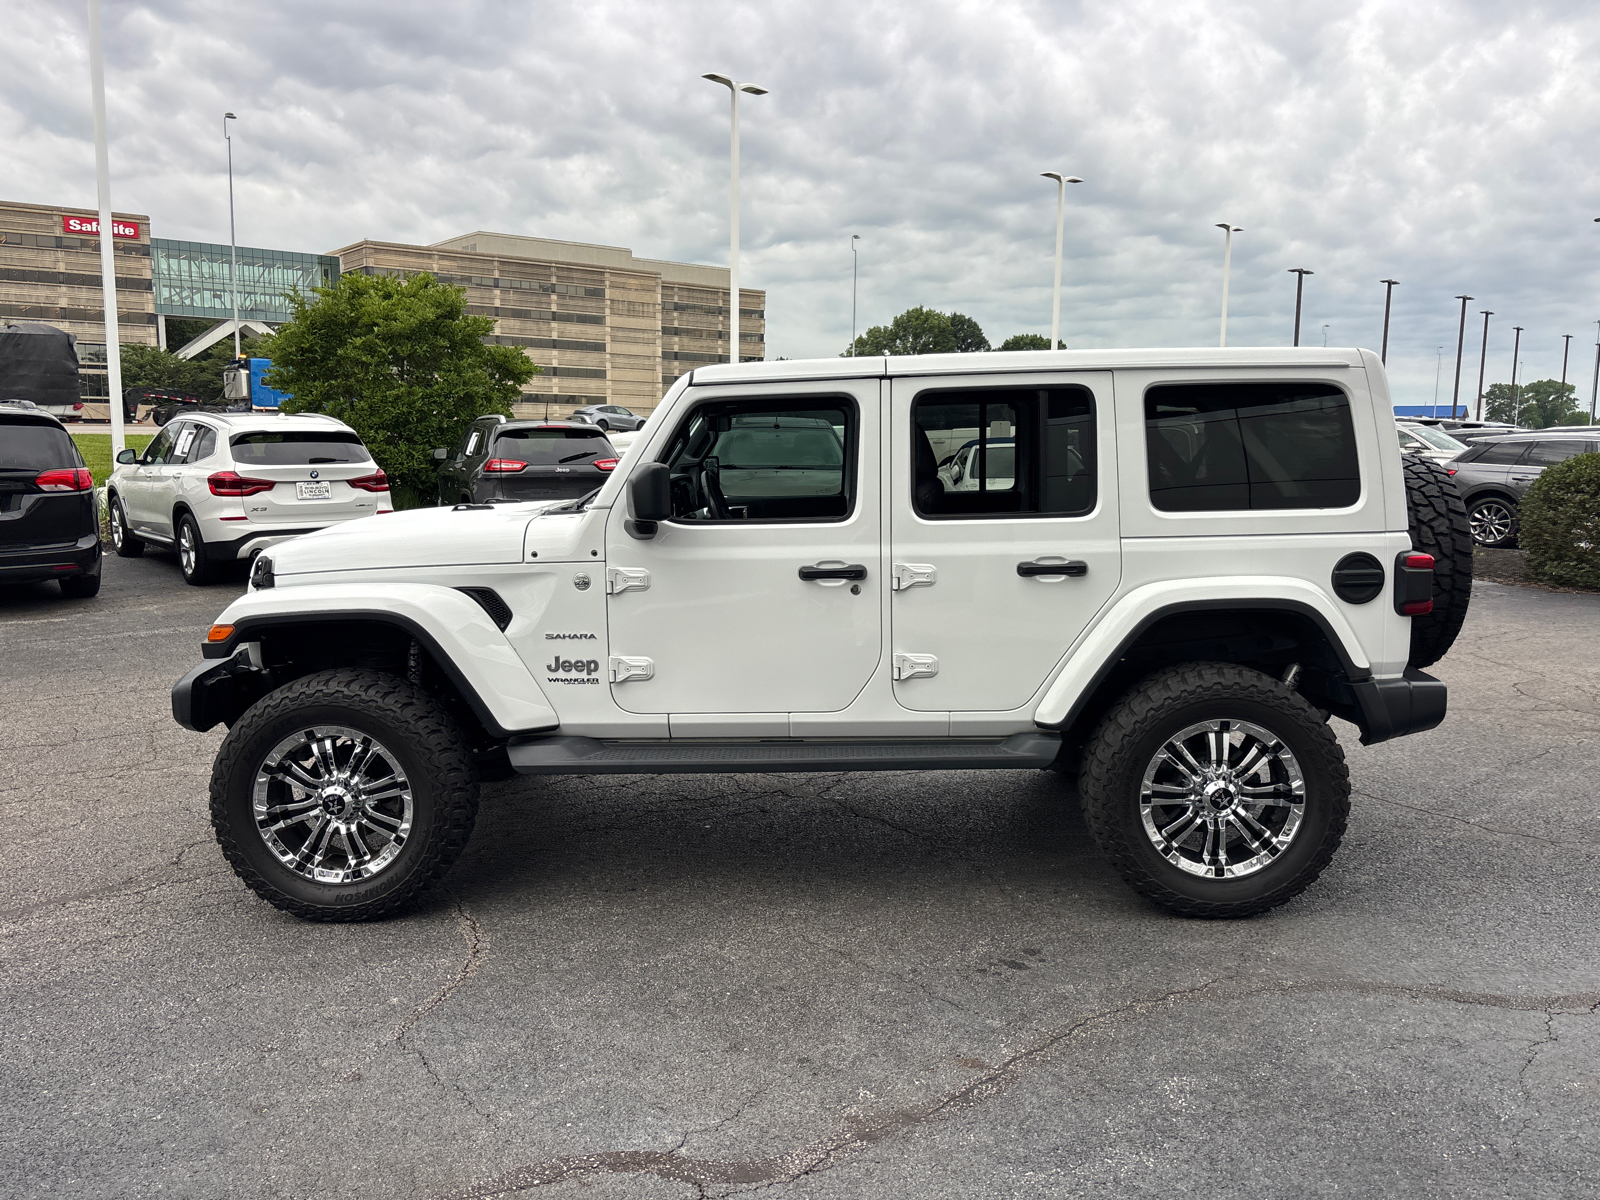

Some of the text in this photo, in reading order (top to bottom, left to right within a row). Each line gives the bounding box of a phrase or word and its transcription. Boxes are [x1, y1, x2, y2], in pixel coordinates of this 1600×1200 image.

[68, 219, 135, 236] Safite
[546, 655, 600, 676] Jeep
[1121, 755, 1141, 828] THOMPSON
[334, 872, 401, 903] THOMPSON
